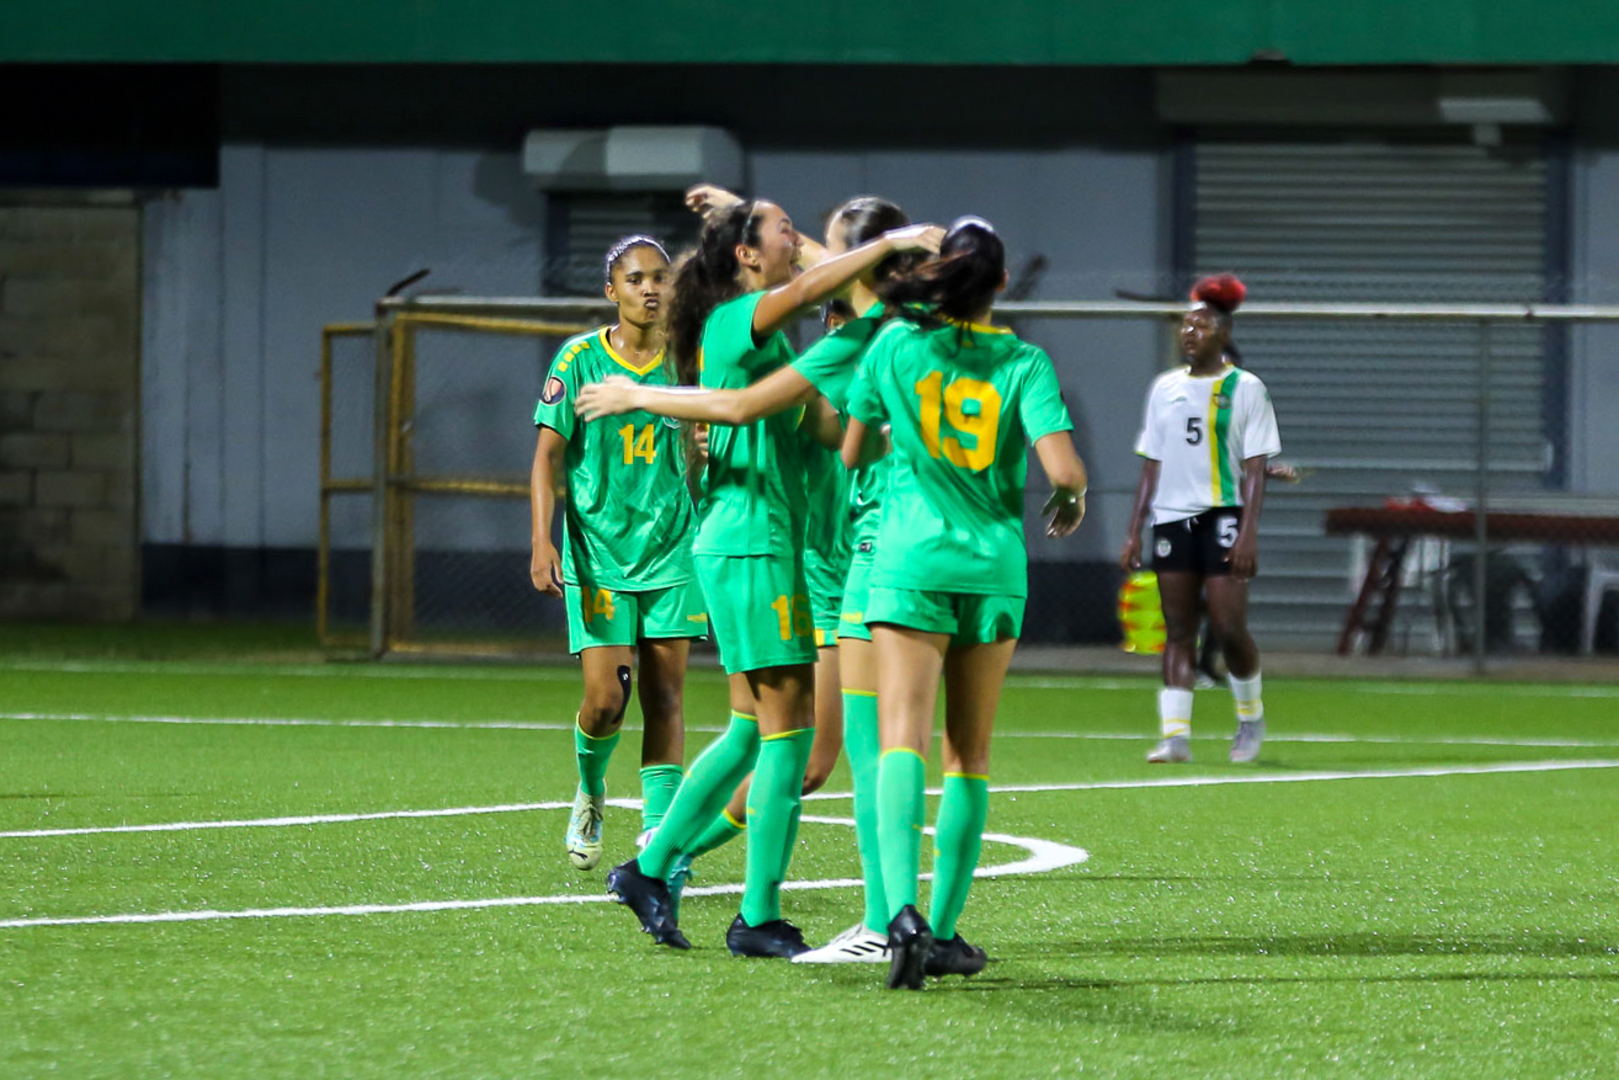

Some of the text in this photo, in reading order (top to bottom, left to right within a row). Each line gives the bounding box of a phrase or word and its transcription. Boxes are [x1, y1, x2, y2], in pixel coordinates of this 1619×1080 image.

[914, 369, 1002, 472] 19
[1186, 417, 1203, 446] 5
[618, 423, 657, 464] 14
[1216, 516, 1239, 548] 5
[581, 586, 616, 623] 14
[771, 594, 812, 641] 16
